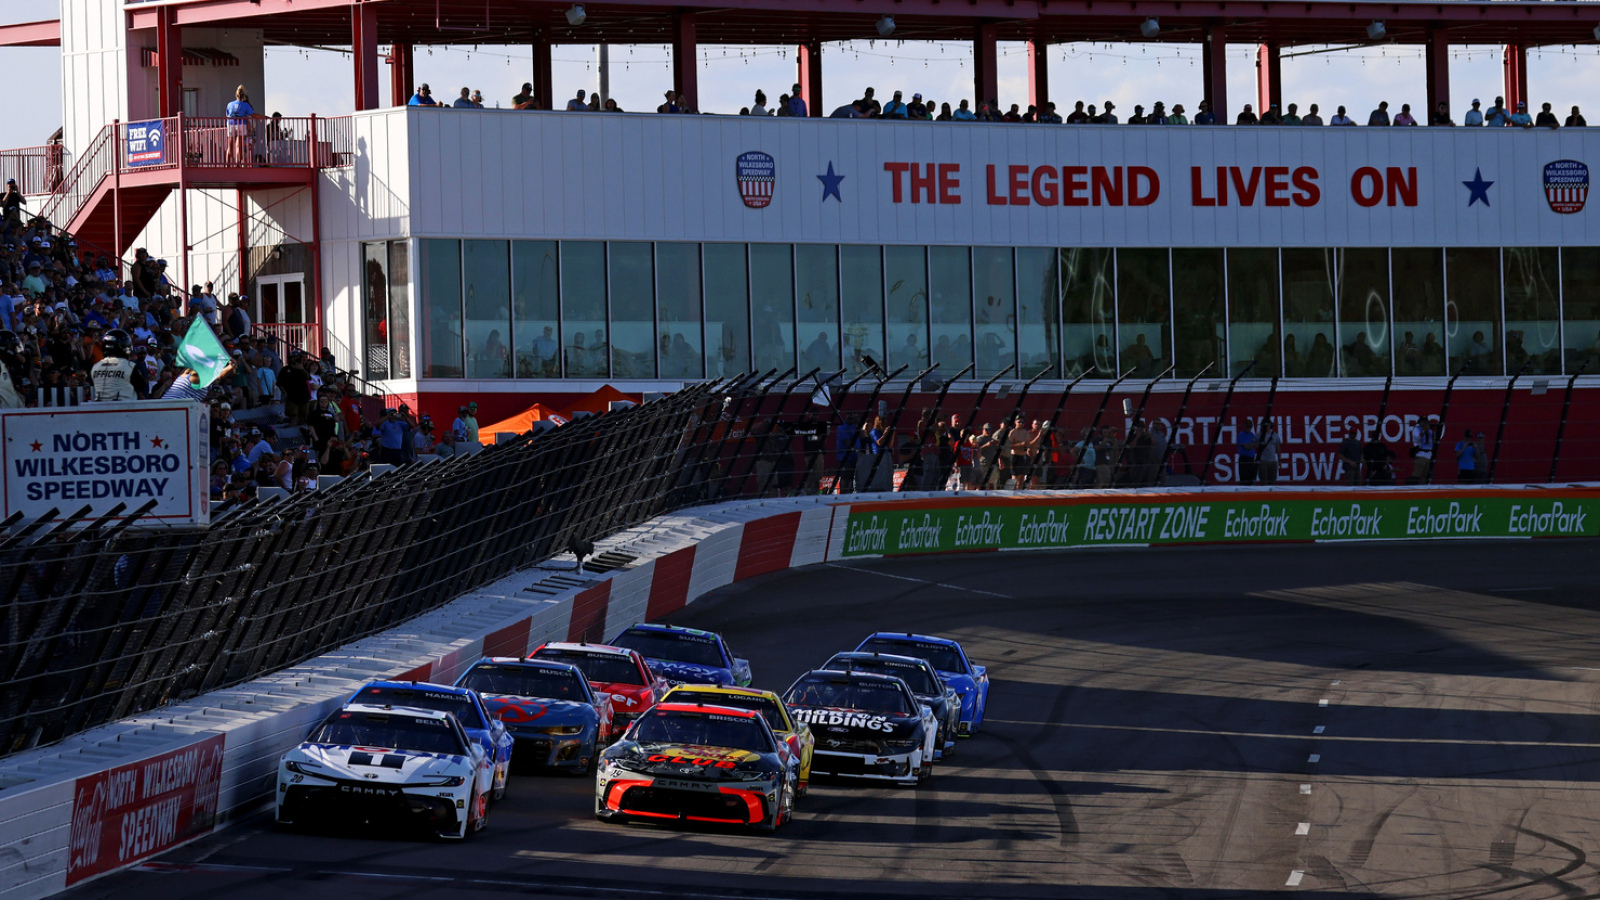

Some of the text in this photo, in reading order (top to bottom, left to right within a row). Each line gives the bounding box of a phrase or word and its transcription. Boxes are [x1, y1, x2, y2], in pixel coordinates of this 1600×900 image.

[129, 127, 147, 140] FREE
[129, 140, 147, 152] WIFI
[739, 161, 774, 169] WILKESBORO
[1545, 169, 1588, 177] WILKESBORO
[884, 162, 1418, 207] THE LEGEND LIVES ON
[93, 370, 125, 379] OFFICIAL
[53, 431, 140, 452] NORTH
[15, 453, 180, 478] WILKESBORO
[26, 477, 169, 501] SPEEDWAY
[1083, 506, 1212, 541] RESTART ZONE
[1224, 504, 1290, 538] EchoPark
[1310, 503, 1383, 536] EchoPark
[1406, 502, 1483, 535] EchoPark
[1508, 501, 1588, 533] EchoPark
[898, 513, 942, 549] EchoPark
[955, 510, 1004, 546] EchoPark
[1017, 509, 1070, 544] EchoPark
[848, 515, 889, 553] EchoPark
[916, 643, 949, 651] ELLIOTT
[539, 668, 573, 678] BUSCH
[858, 681, 896, 690] BURTON
[425, 692, 467, 702] HAMLIN
[728, 694, 766, 703] LOGANO
[708, 714, 755, 724] BRISCOE
[792, 708, 888, 722] MORTON
[415, 718, 443, 727] BELL
[647, 754, 737, 769] CLUB
[106, 747, 199, 812] NORTH WILKESBORO
[290, 774, 304, 783] 20
[610, 769, 624, 778] 19
[341, 785, 399, 796] CAMRY
[657, 780, 713, 790] CAMRY
[118, 795, 183, 863] SPEEDWAY
